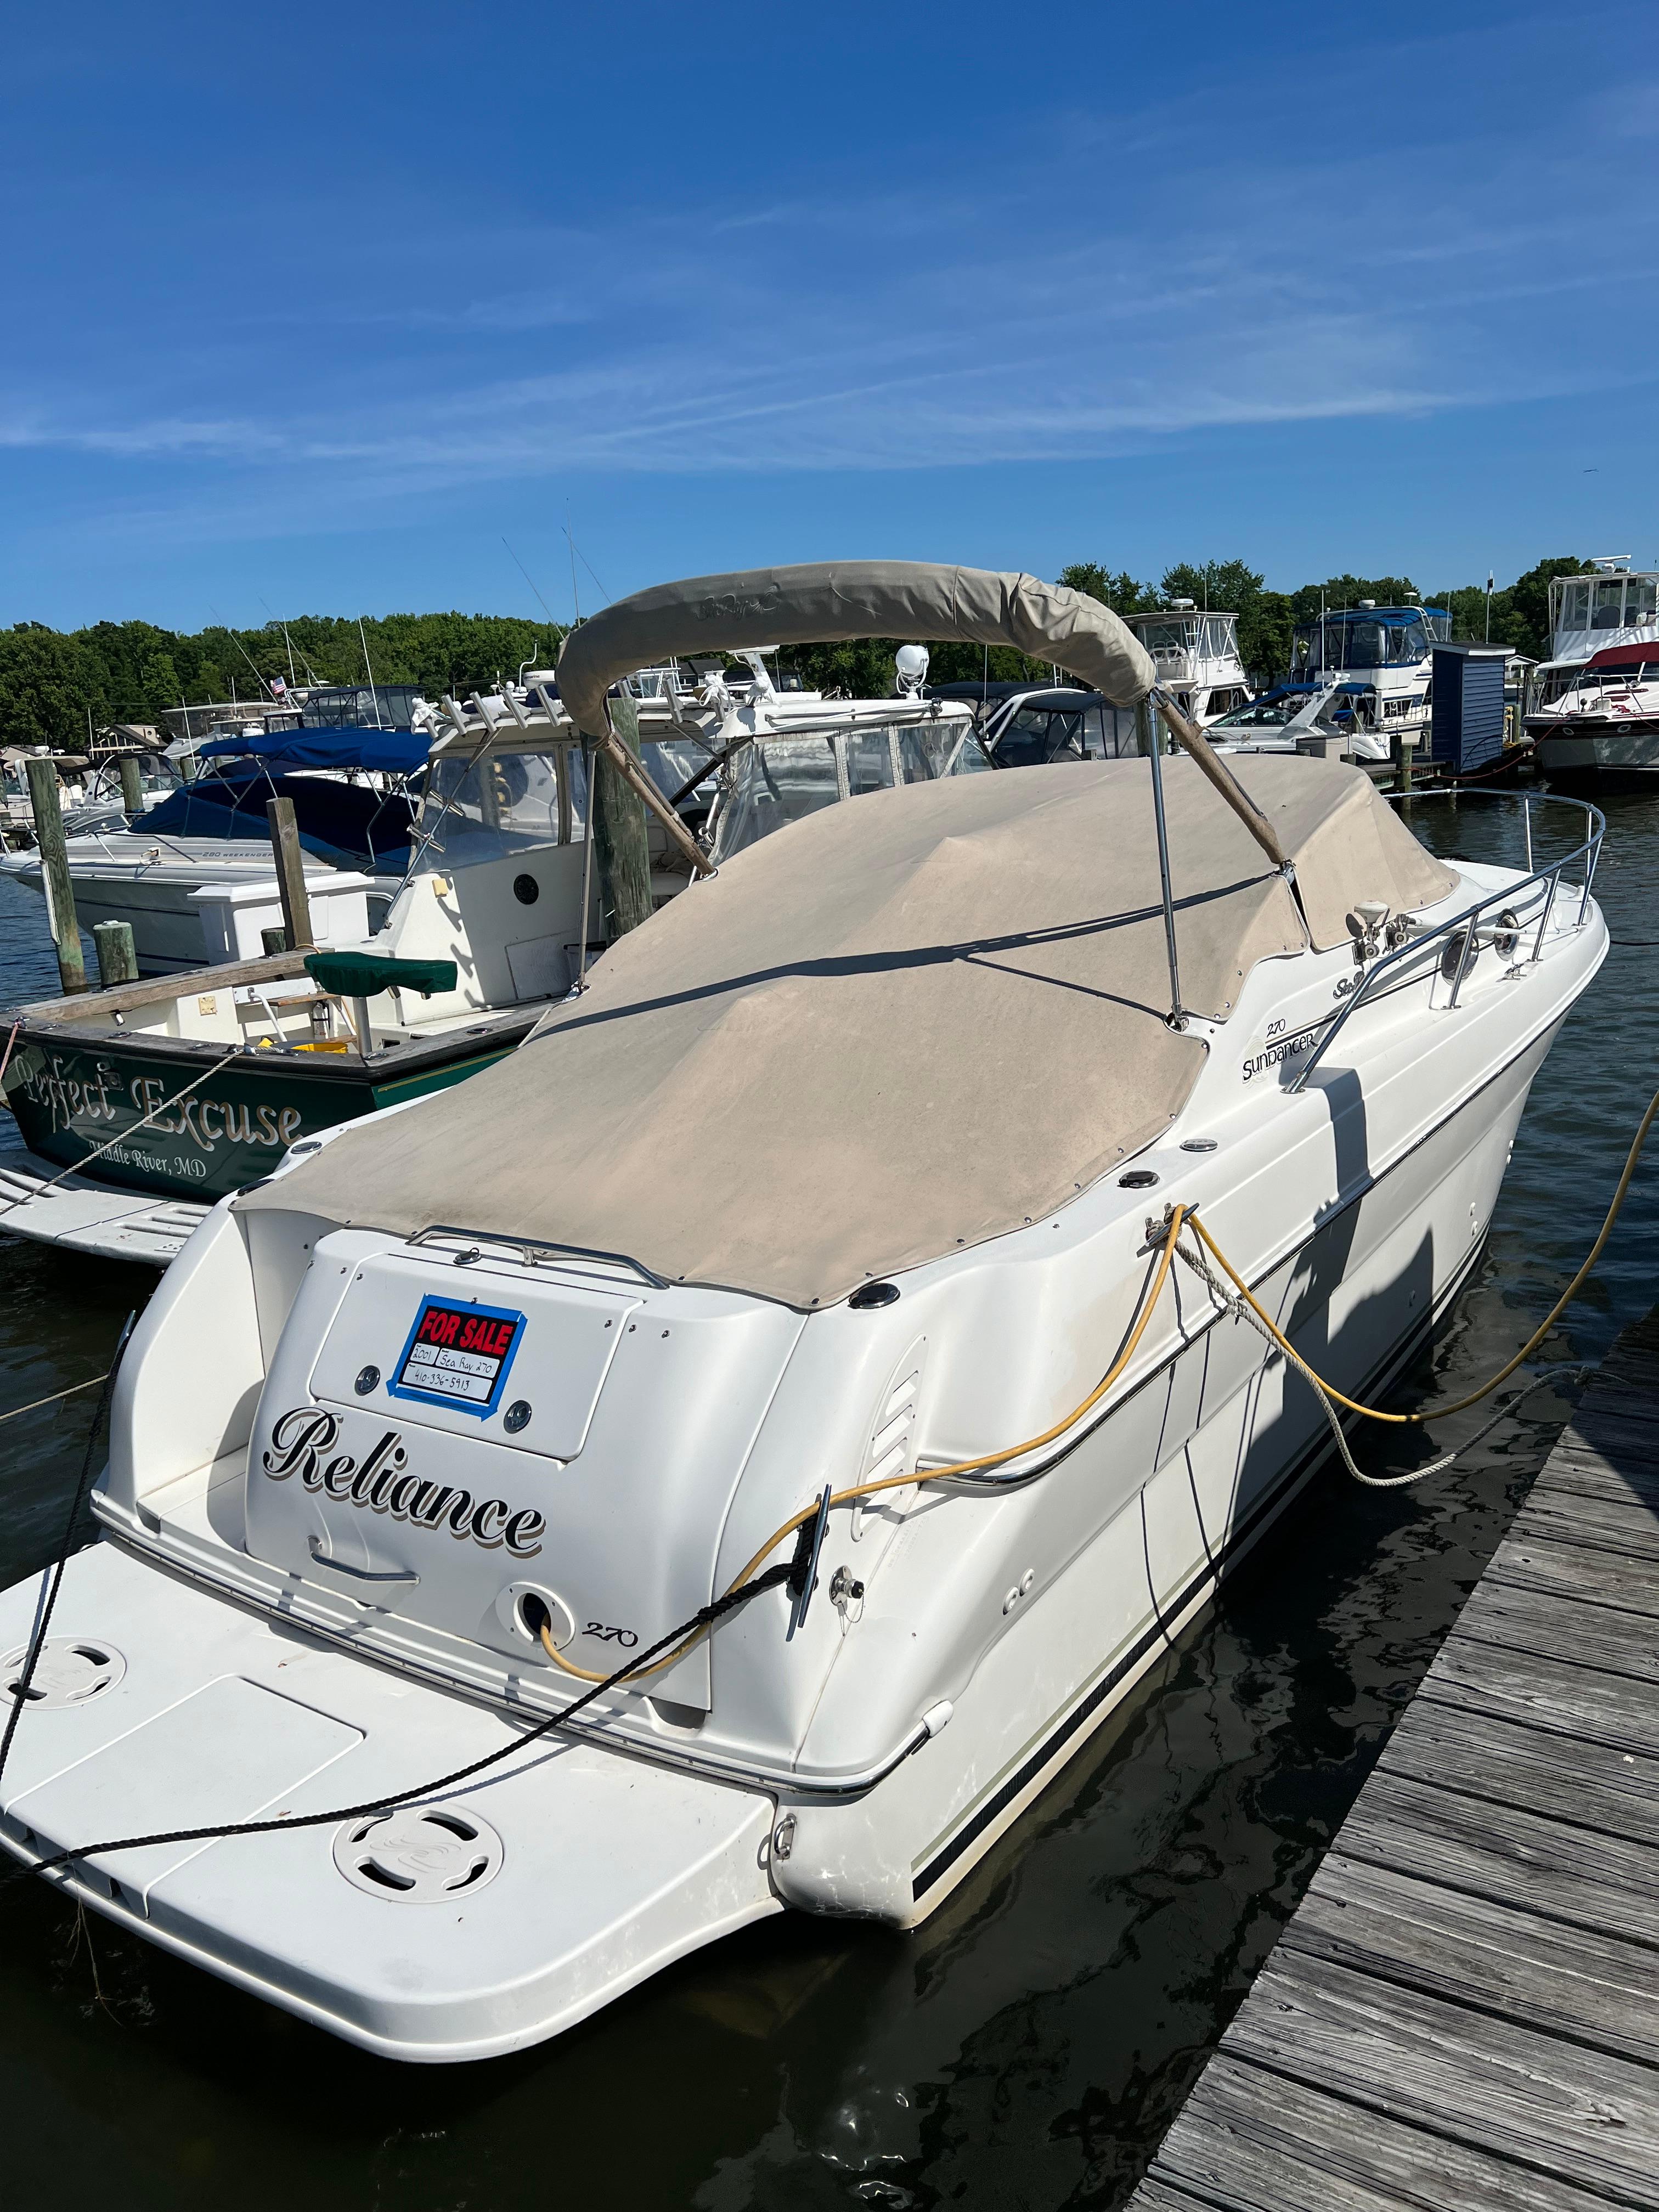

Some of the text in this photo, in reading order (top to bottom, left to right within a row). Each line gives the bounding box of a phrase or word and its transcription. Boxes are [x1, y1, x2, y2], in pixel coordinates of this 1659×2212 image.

[1267, 1018, 1285, 1038] 270
[15, 1054, 303, 1152] Perfect Excuse
[132, 1150, 172, 1176] River,
[174, 1156, 206, 1177] MD
[418, 1311, 514, 1355] FOR SALE
[413, 1348, 432, 1361] 2001
[440, 1355, 492, 1373] Sea Ray 270
[262, 1406, 548, 1560] Reliance
[582, 1622, 639, 1647] 270
